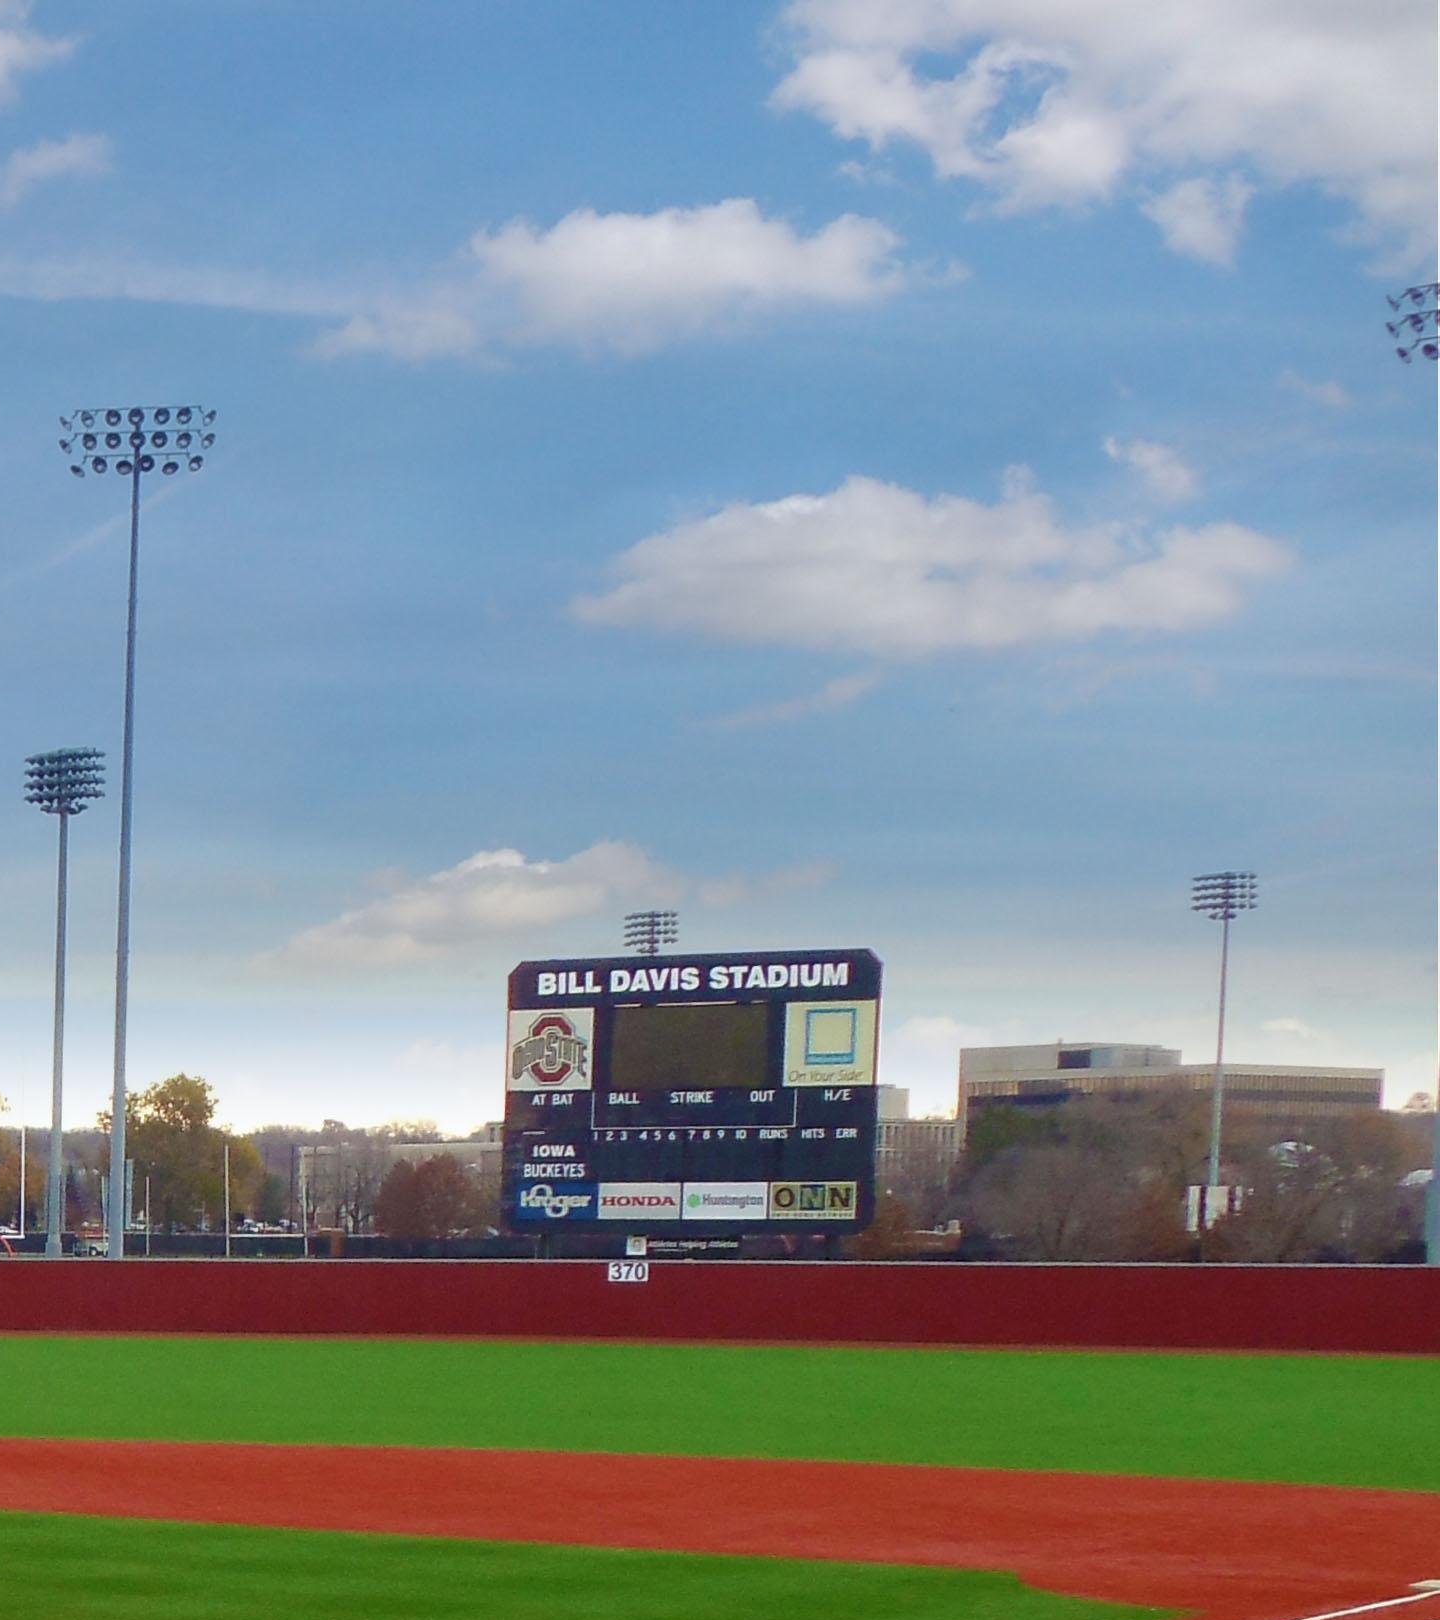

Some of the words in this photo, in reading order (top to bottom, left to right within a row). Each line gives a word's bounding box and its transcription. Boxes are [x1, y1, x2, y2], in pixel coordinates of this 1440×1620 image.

[537, 970, 603, 996] BILL
[610, 966, 700, 993] DAVIS
[708, 962, 849, 990] STADIUM
[531, 1093, 546, 1106] AT
[551, 1093, 575, 1106] BAT
[608, 1092, 640, 1105] BALL
[670, 1090, 714, 1104] STRIKE
[749, 1089, 776, 1103] OUT
[824, 1088, 853, 1101] H/E
[593, 1130, 599, 1141] 1
[605, 1131, 614, 1141] 2
[620, 1130, 628, 1141] 3
[639, 1130, 648, 1141] 4
[654, 1130, 662, 1141] 5
[668, 1130, 676, 1140] 6
[688, 1130, 697, 1140] 7
[702, 1130, 711, 1140] 8
[717, 1129, 725, 1139] 9
[735, 1129, 747, 1139] 10
[759, 1129, 788, 1139] RUNS
[801, 1128, 825, 1139] HITS
[835, 1128, 858, 1139] ERR
[532, 1145, 576, 1158] IOWA
[523, 1163, 586, 1178] BUCKEYES
[520, 1184, 592, 1218] Kroger
[601, 1196, 676, 1206] HONDA
[702, 1193, 764, 1209] Huntington
[774, 1186, 852, 1208] ONN
[611, 1263, 646, 1280] 370
